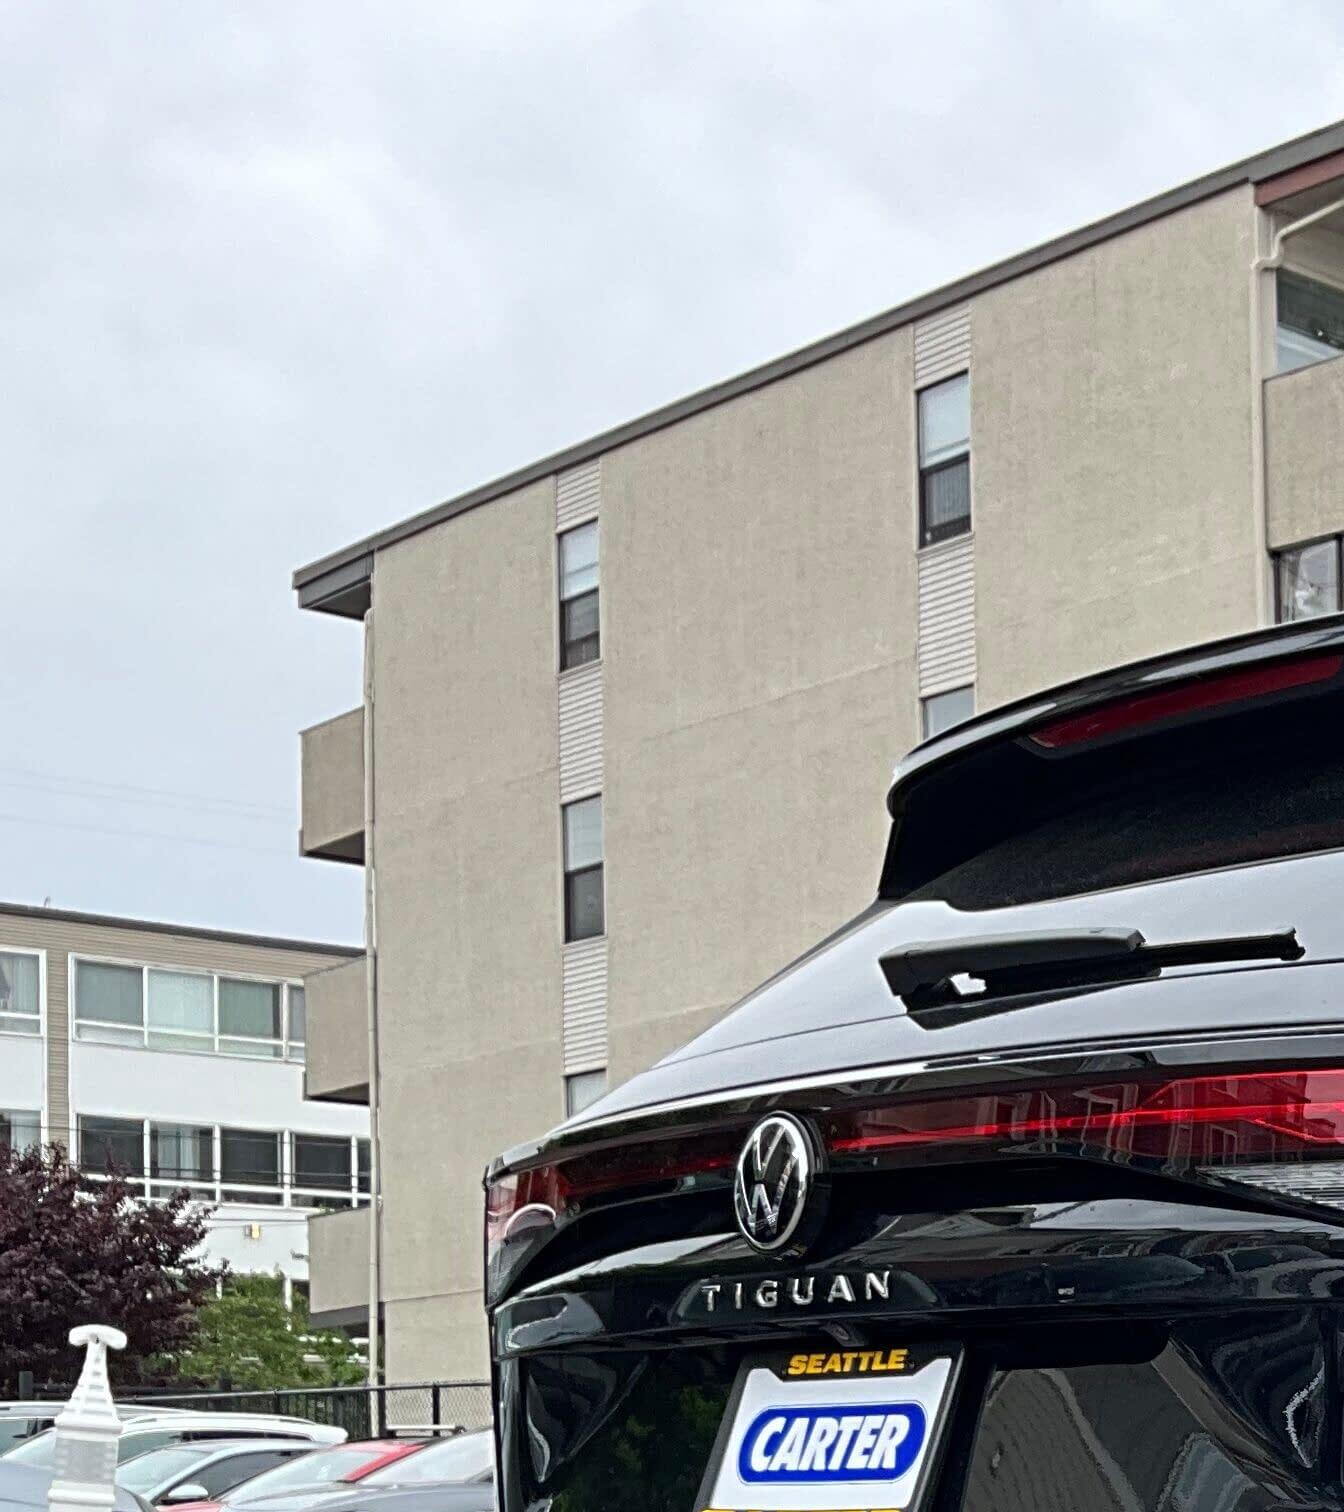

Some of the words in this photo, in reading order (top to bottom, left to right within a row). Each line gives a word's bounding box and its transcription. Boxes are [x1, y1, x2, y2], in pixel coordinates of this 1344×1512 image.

[701, 1270, 890, 1311] TIGUAN
[788, 1349, 909, 1375] SEATTLE
[750, 1414, 911, 1472] CARTER
